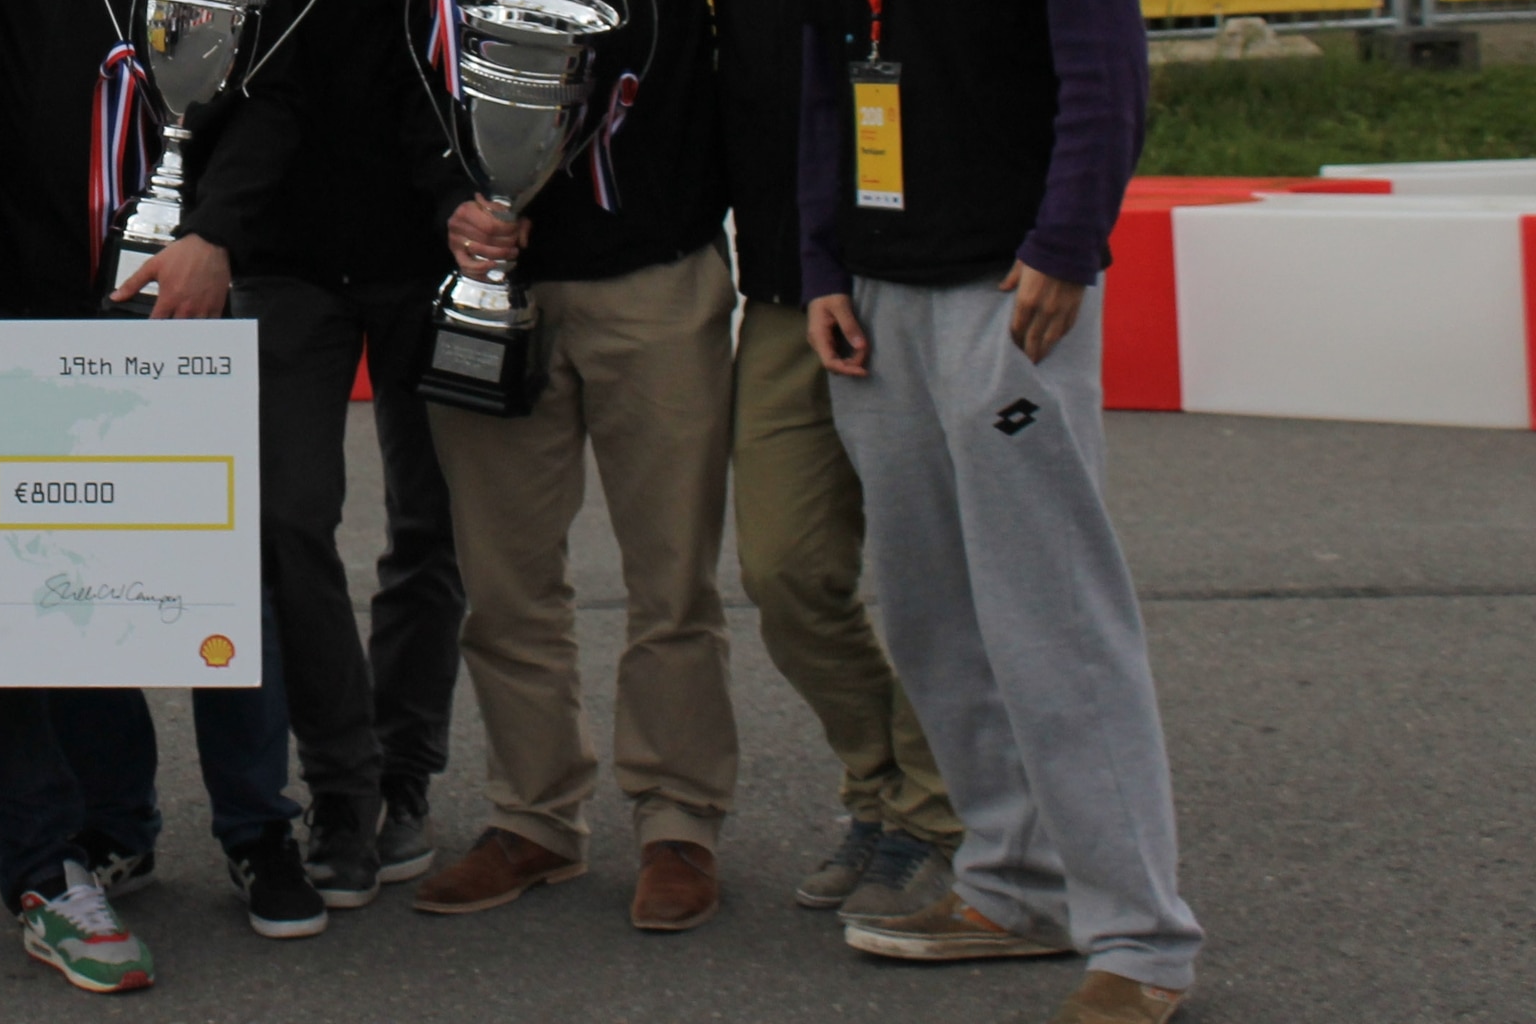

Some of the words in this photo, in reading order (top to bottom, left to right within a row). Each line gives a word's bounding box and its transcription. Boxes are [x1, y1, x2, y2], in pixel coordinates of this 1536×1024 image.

[59, 356, 112, 376] 19th
[125, 356, 165, 380] May
[177, 356, 232, 376] 2013
[14, 482, 115, 504] €800.00
